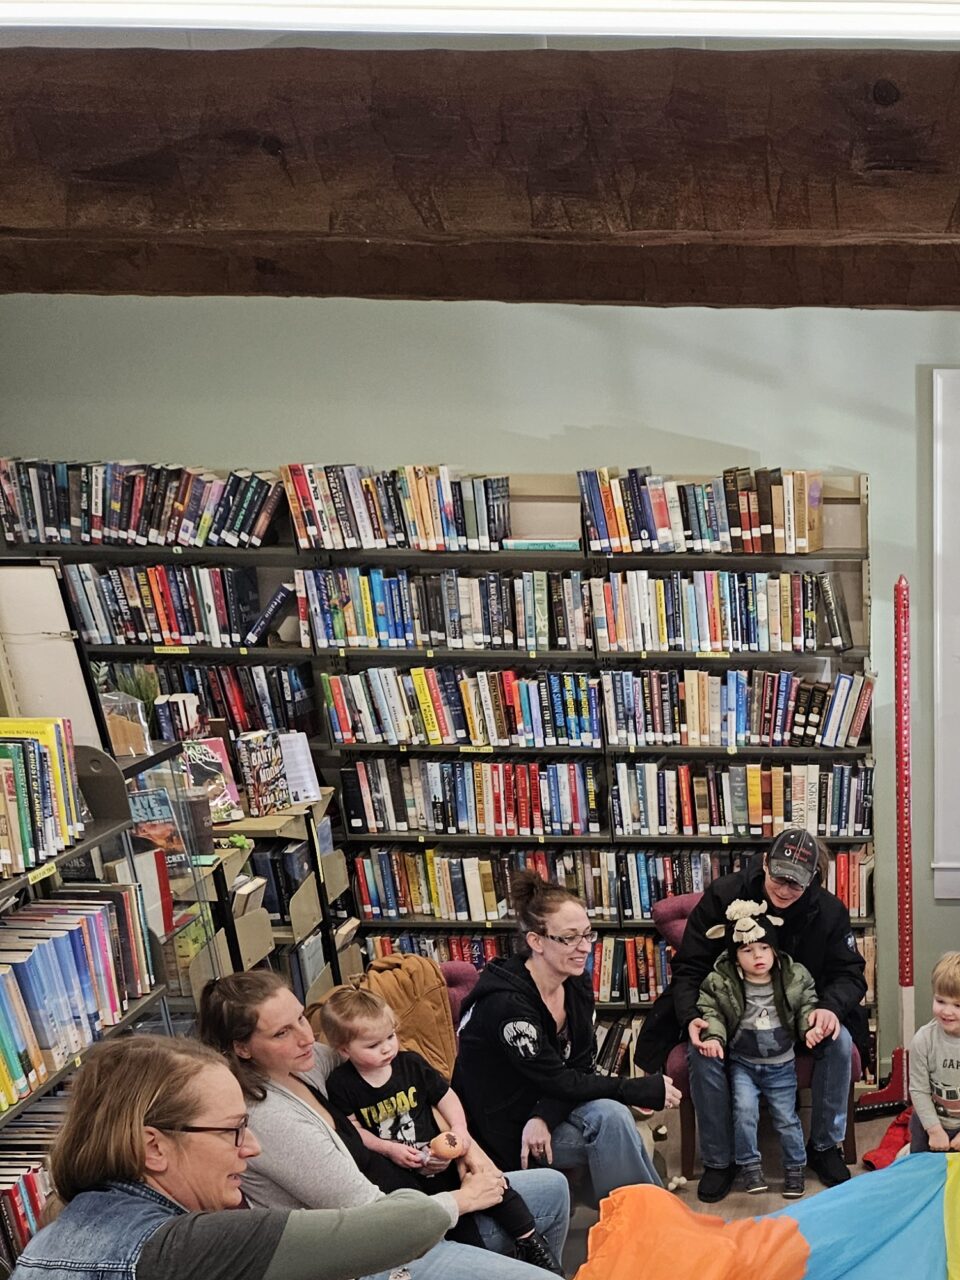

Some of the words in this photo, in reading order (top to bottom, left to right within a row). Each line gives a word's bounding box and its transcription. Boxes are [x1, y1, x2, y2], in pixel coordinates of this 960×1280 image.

[108, 570, 124, 597] BRUSH
[489, 674, 498, 692] RUTH
[549, 674, 560, 692] JOHN
[778, 674, 787, 690] BRAD
[492, 694, 501, 711] WARE
[777, 692, 785, 708] THOR
[552, 693, 564, 726] SANDFORD
